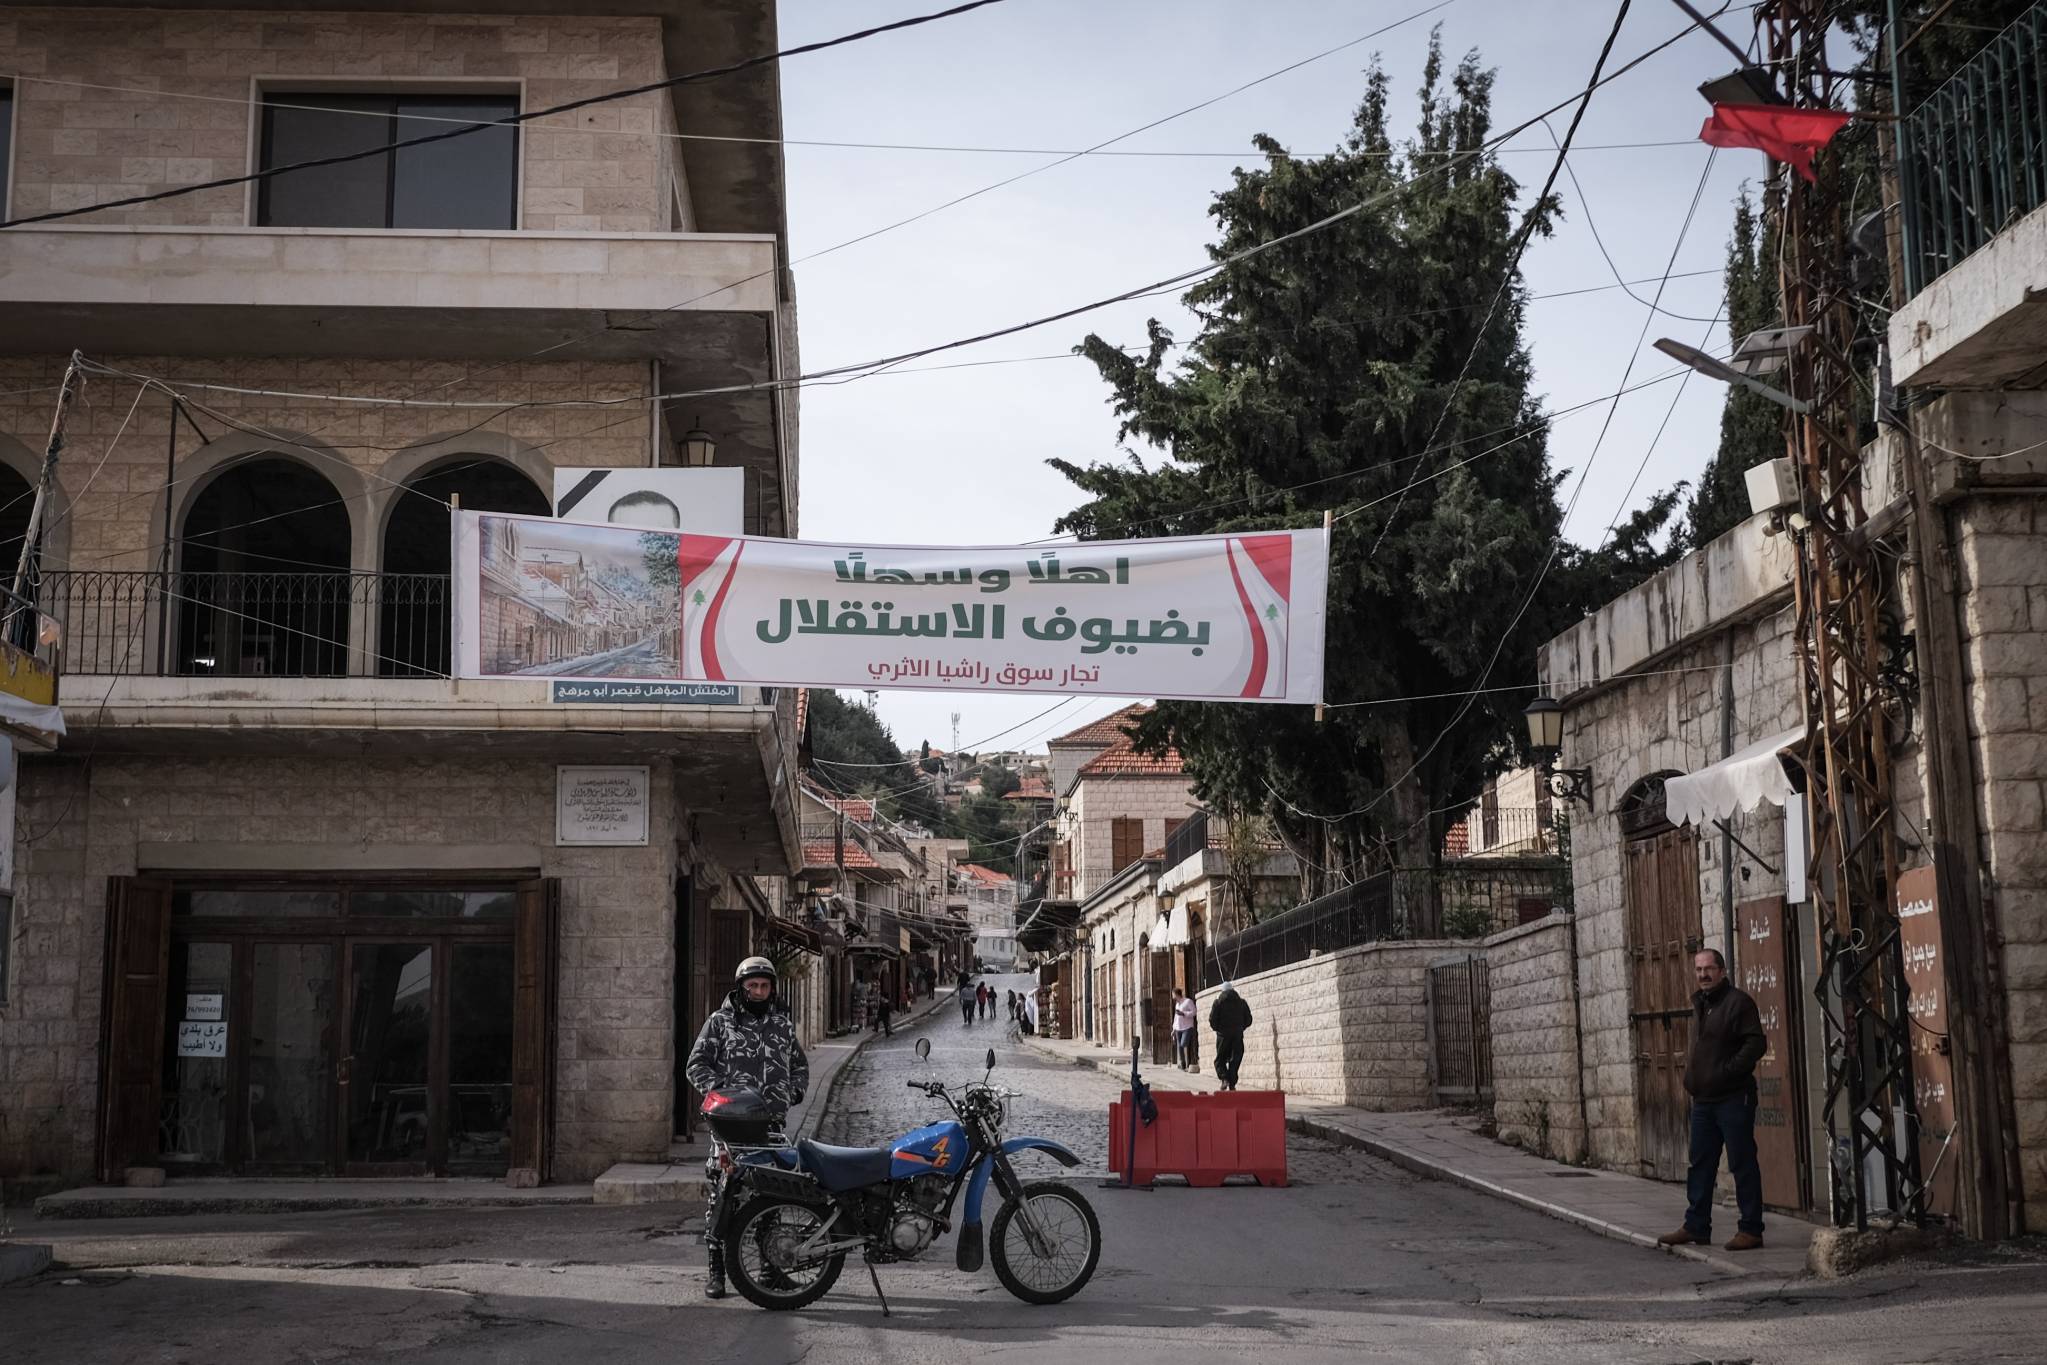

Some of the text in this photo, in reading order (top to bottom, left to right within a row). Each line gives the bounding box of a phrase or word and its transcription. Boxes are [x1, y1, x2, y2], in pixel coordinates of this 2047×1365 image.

[756, 598, 1210, 657] بضيوف الاستقلال
[936, 660, 990, 684] راشيا
[996, 663, 1053, 685] سوق
[1059, 664, 1099, 684] تجار
[558, 685, 734, 697] المفتش المؤهل قيصر أبو مرهج
[1749, 915, 1771, 944] شباط
[204, 1025, 226, 1037] عرق
